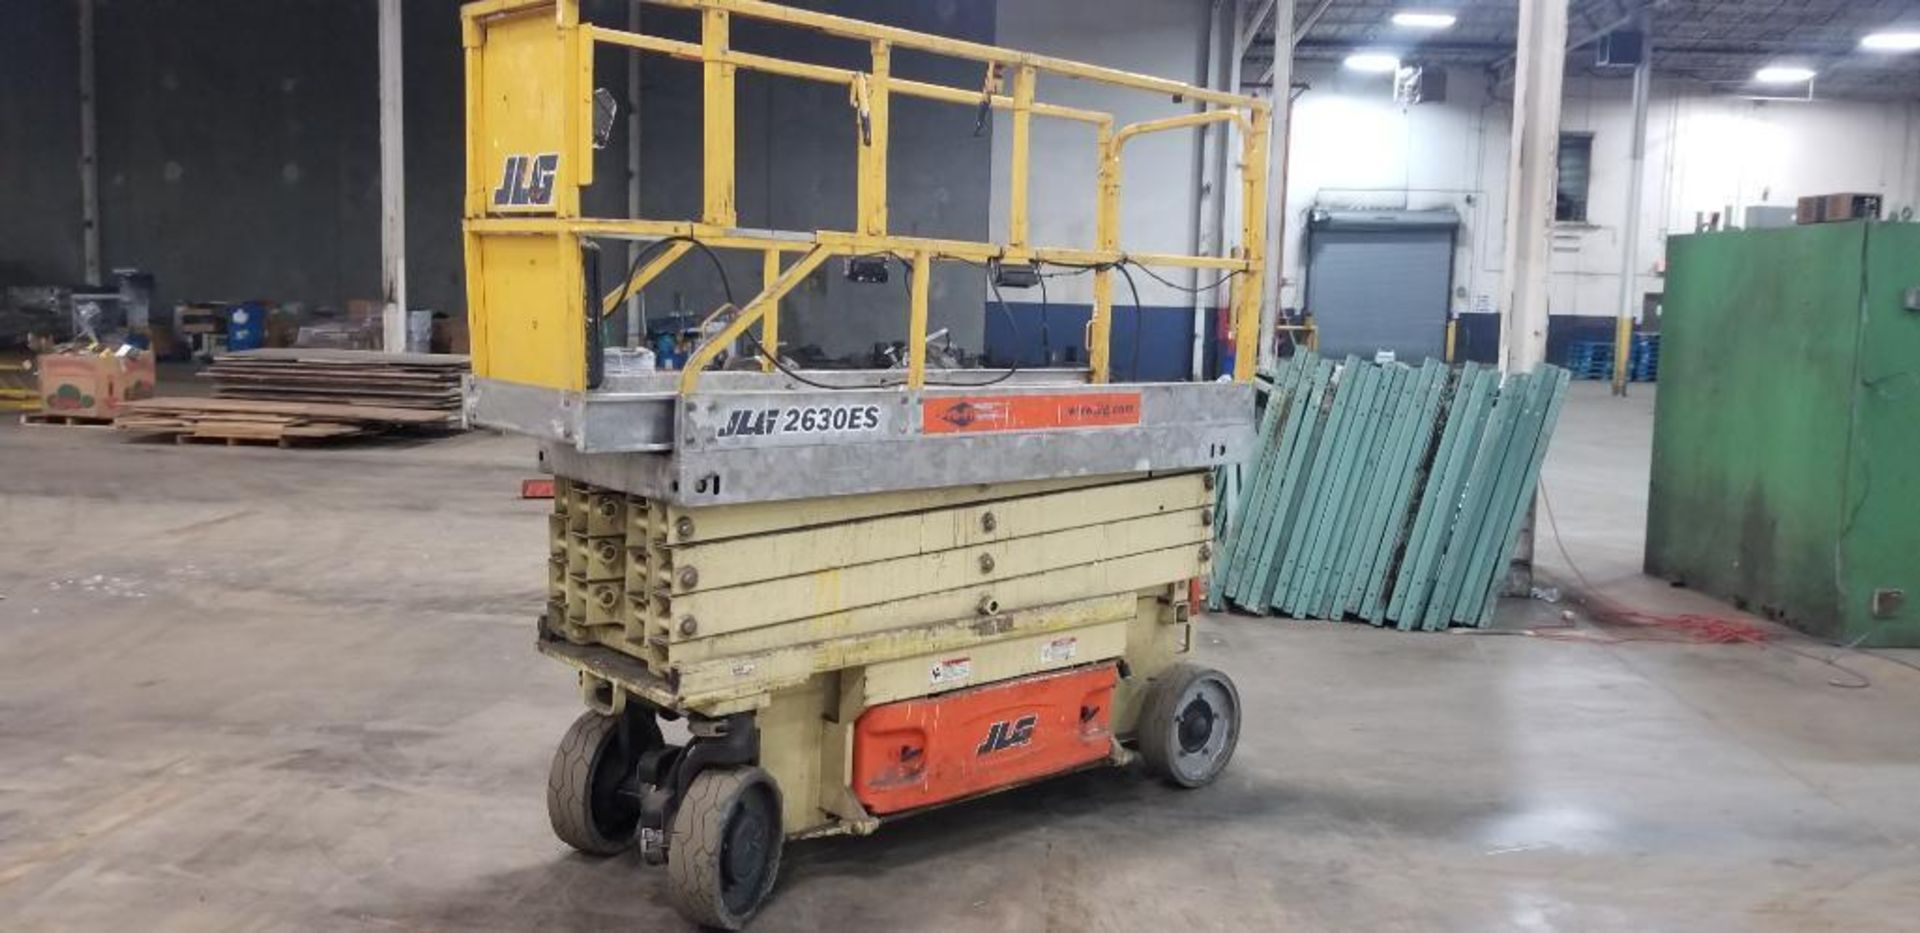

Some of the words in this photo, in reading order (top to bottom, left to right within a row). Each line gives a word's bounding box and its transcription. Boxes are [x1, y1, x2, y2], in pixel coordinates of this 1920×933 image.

[494, 154, 559, 205] JLG
[717, 409, 780, 437] JLG
[783, 406, 880, 432] 2630ES
[976, 716, 1036, 755] JLG
